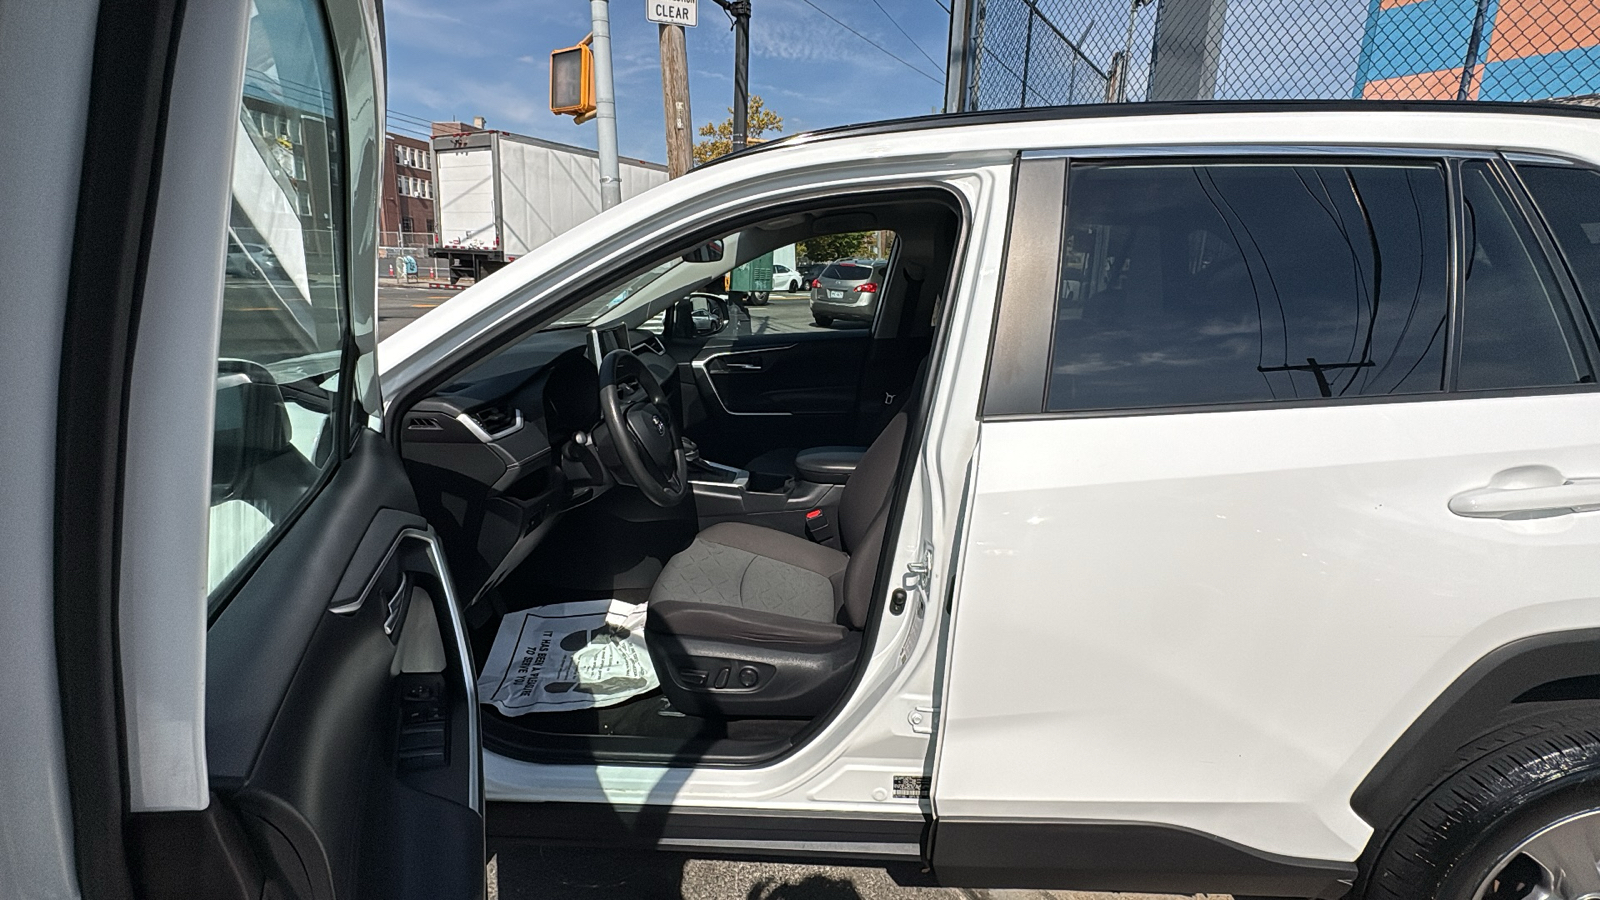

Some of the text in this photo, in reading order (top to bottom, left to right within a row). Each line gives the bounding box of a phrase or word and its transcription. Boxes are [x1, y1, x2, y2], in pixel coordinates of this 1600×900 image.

[656, 4, 689, 20] CLEAR
[539, 640, 551, 651] HAS
[513, 647, 536, 685] TO SERVE YOU
[534, 653, 547, 666] BEEN
[520, 673, 539, 697] PLEASURE
